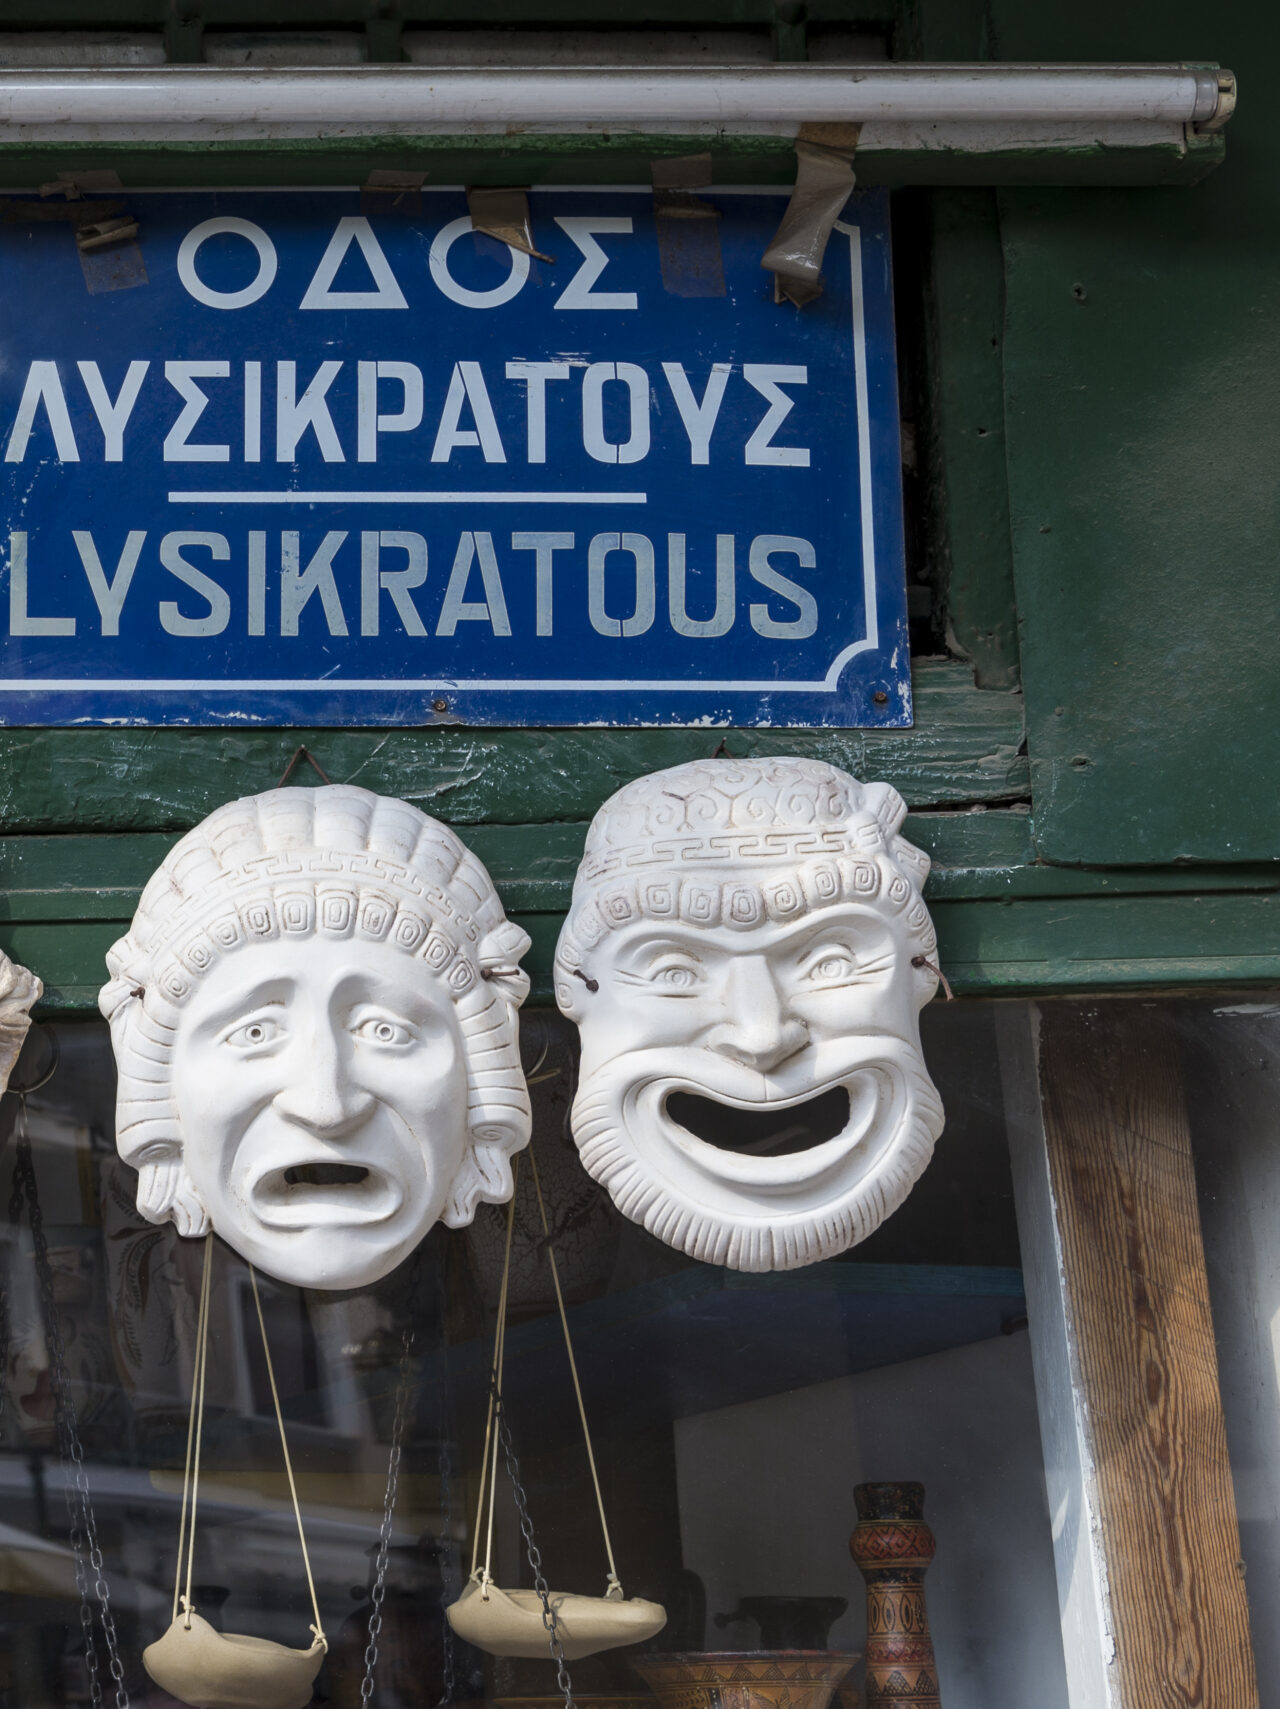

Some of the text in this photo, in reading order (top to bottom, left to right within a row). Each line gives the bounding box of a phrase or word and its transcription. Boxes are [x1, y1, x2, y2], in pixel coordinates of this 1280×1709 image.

[177, 216, 638, 310] ΟΔΟΣ
[5, 360, 811, 467] ΛΥΣΙΚΡΑΤΟΥΣ
[8, 530, 818, 639] LYSIKRATOUS
